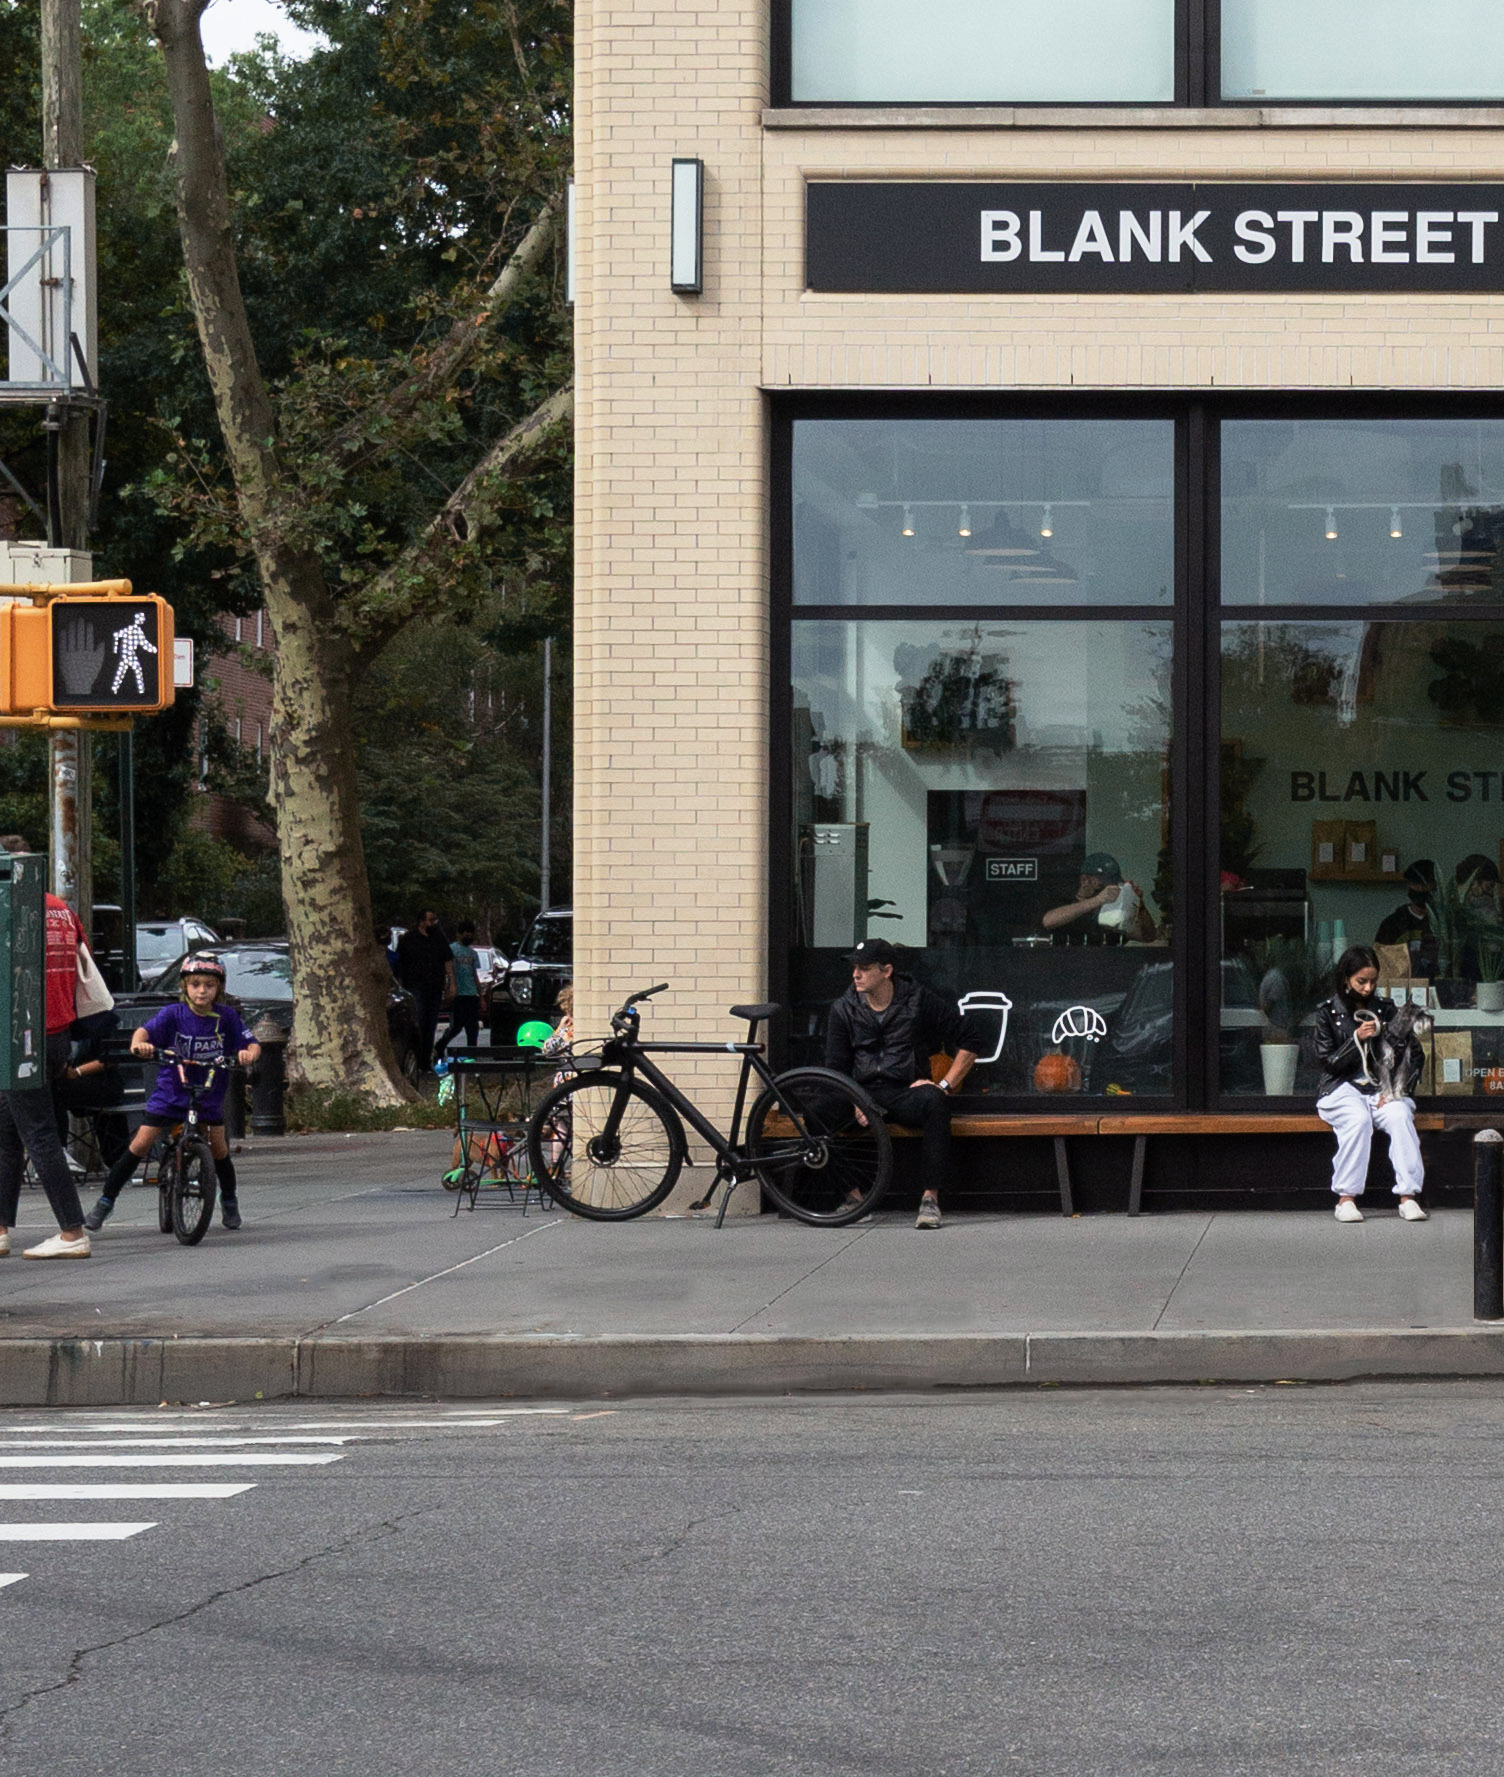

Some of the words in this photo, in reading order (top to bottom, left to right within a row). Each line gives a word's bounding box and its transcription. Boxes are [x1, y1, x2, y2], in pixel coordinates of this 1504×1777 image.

[979, 210, 1214, 263] BLANK
[1233, 209, 1499, 265] STREET
[1290, 771, 1429, 802] BLANK
[990, 863, 1034, 876] STAFF
[1465, 1067, 1496, 1078] OPEN
